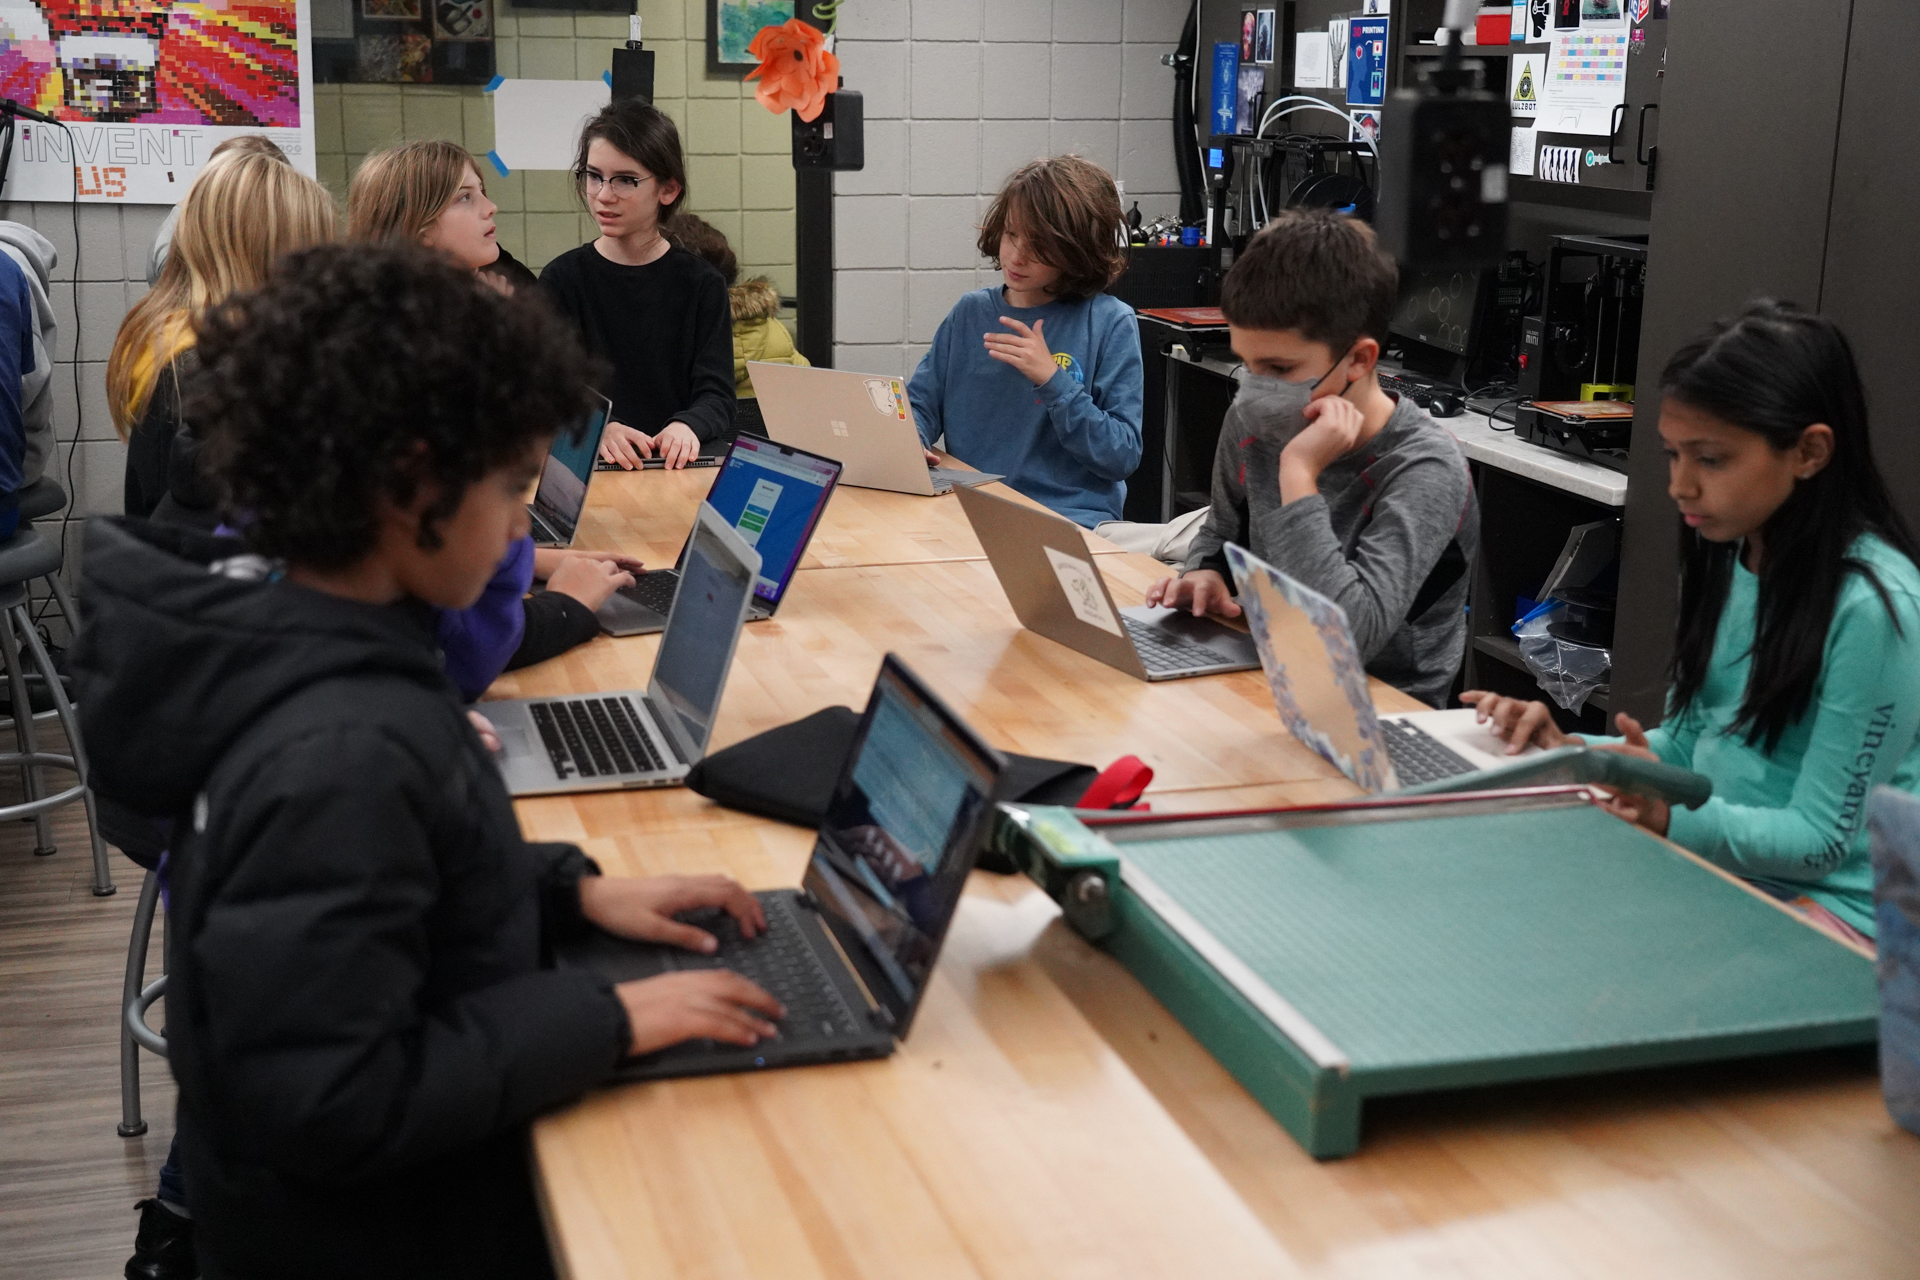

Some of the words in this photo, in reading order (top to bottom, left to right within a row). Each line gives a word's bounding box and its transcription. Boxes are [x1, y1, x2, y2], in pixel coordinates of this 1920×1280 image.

[1352, 26, 1362, 38] 3D
[1362, 25, 1385, 34] PRINTING
[1512, 102, 1537, 111] LULZBOT
[21, 124, 203, 166] INVENT
[75, 165, 127, 198] US
[1835, 702, 1896, 832] vineyard
